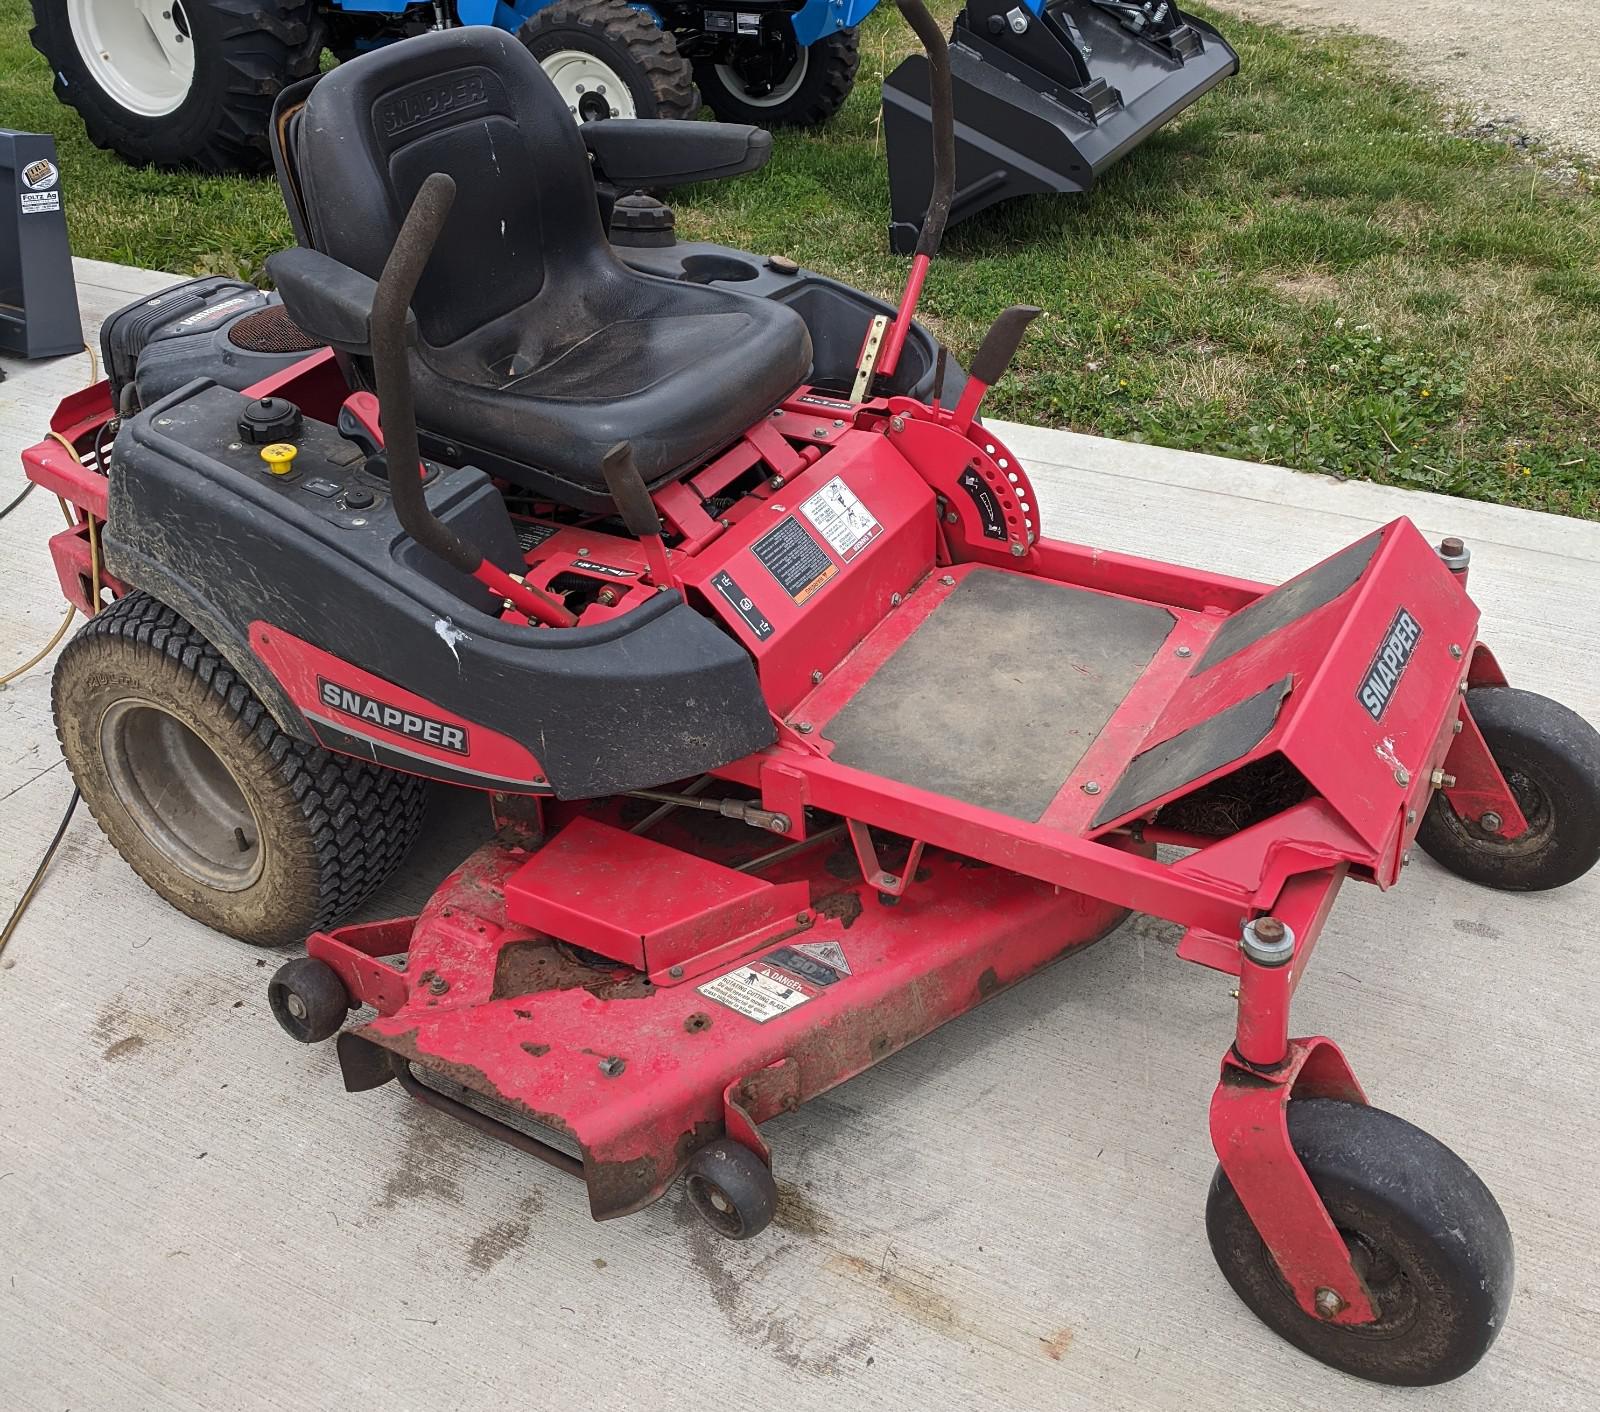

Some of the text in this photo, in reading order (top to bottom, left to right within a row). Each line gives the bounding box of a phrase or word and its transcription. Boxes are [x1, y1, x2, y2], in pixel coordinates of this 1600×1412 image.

[384, 76, 484, 132] SNAPPER
[1362, 611, 1419, 717] SNAPPER
[323, 683, 465, 750] SNAPPER
[722, 977, 748, 993] ROTATING
[746, 989, 770, 1004] CUTTING
[771, 972, 803, 991] DANGER
